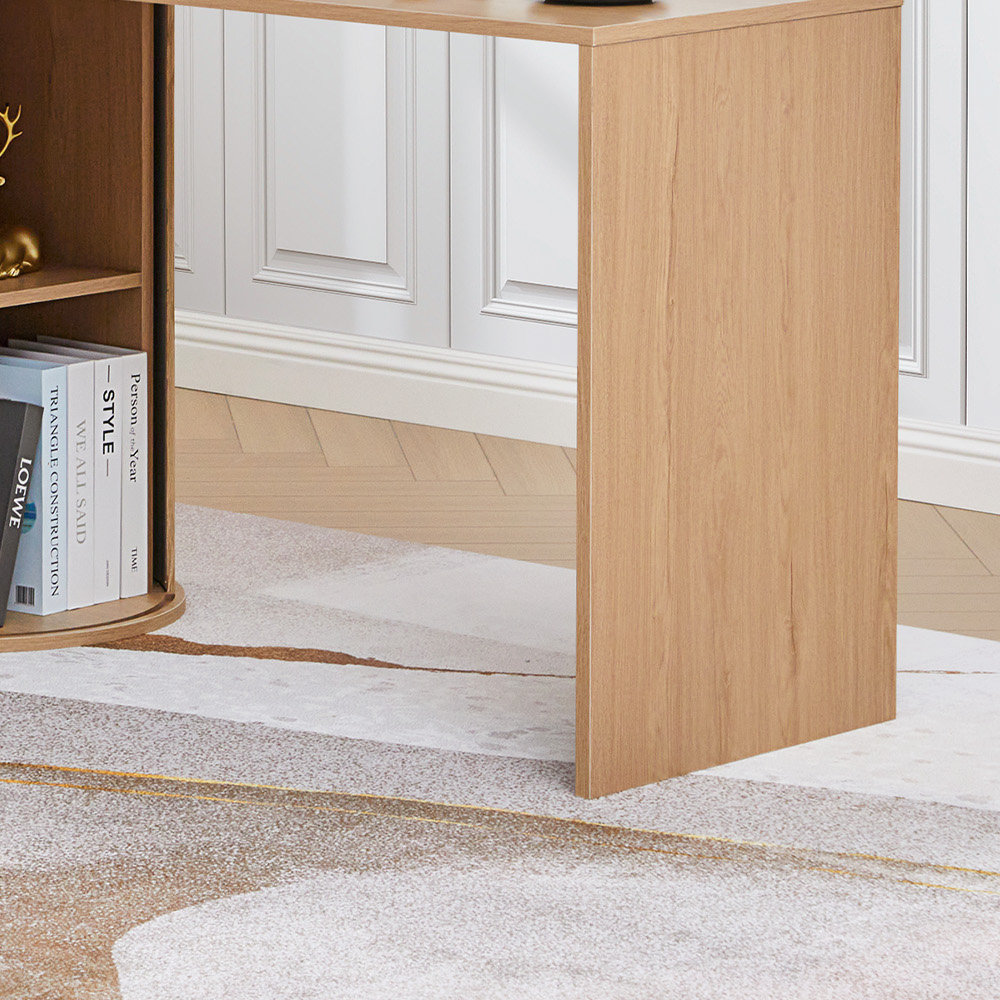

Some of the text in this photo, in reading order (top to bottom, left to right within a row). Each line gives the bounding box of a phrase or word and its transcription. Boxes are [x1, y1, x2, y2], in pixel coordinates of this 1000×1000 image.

[103, 389, 115, 455] STYLE
[129, 426, 136, 435] of
[131, 373, 141, 425] Person
[9, 457, 32, 529] LOEWE
[50, 385, 60, 597] TRIANGLE CONSTRUCTION
[76, 419, 87, 545] WE ALL SAID
[130, 449, 139, 482] Year
